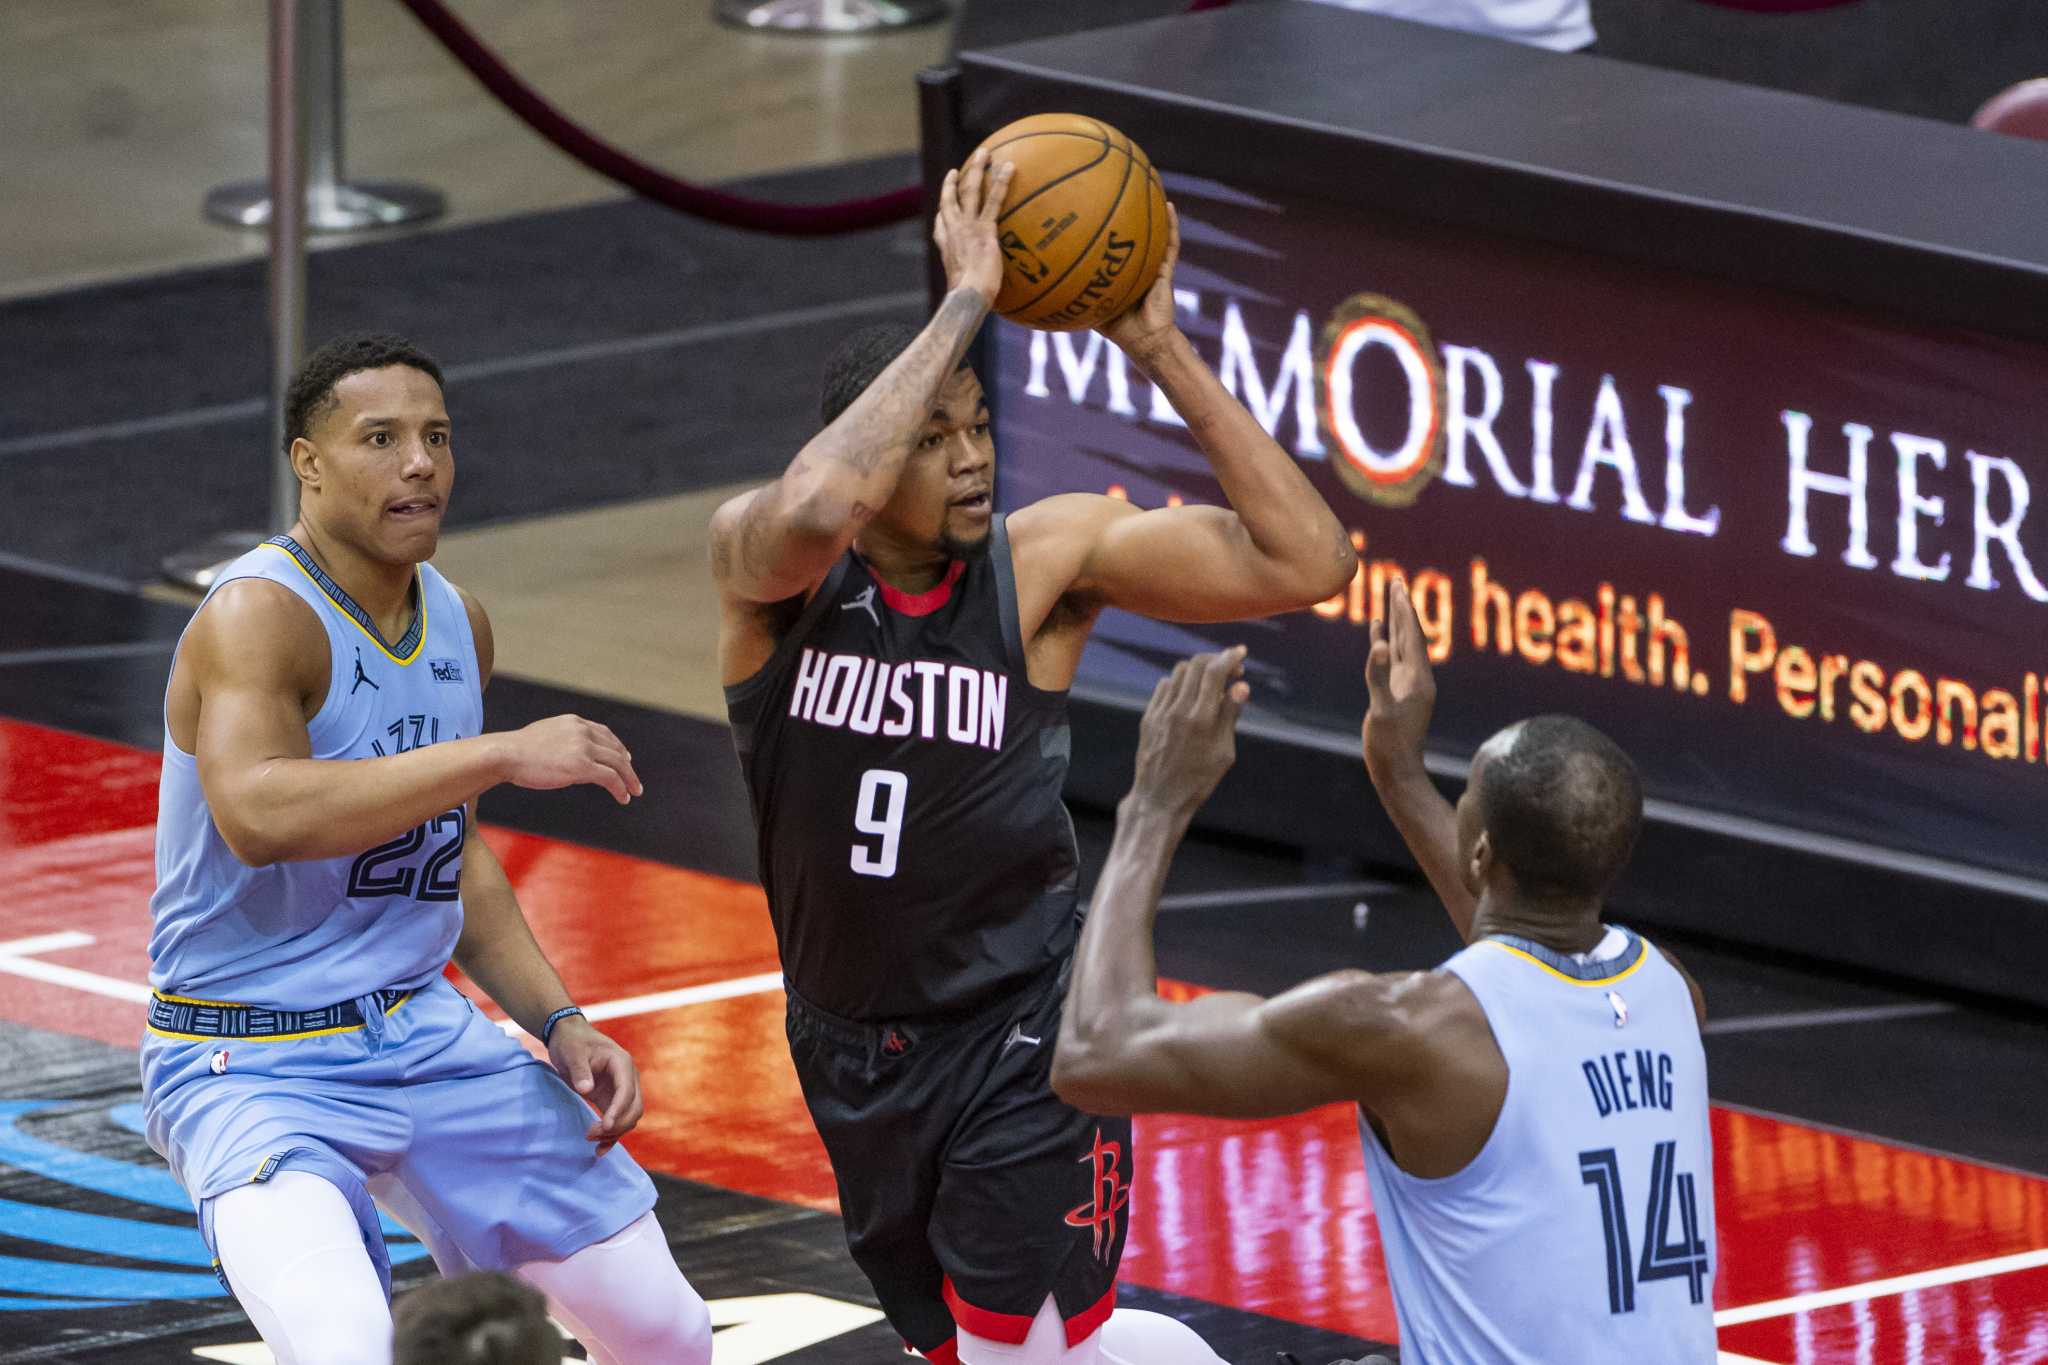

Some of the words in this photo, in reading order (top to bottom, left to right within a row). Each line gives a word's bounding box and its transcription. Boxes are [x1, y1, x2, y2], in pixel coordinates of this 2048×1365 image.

[1038, 231, 1137, 325] SPALDI
[1781, 409, 2048, 602] HER
[1469, 555, 1709, 695] health.
[790, 648, 1007, 750] HOUSTON
[346, 805, 466, 901] 22
[850, 769, 908, 878] 9
[1582, 1049, 1673, 1118] DIENG
[1578, 1140, 1708, 1315] 14
